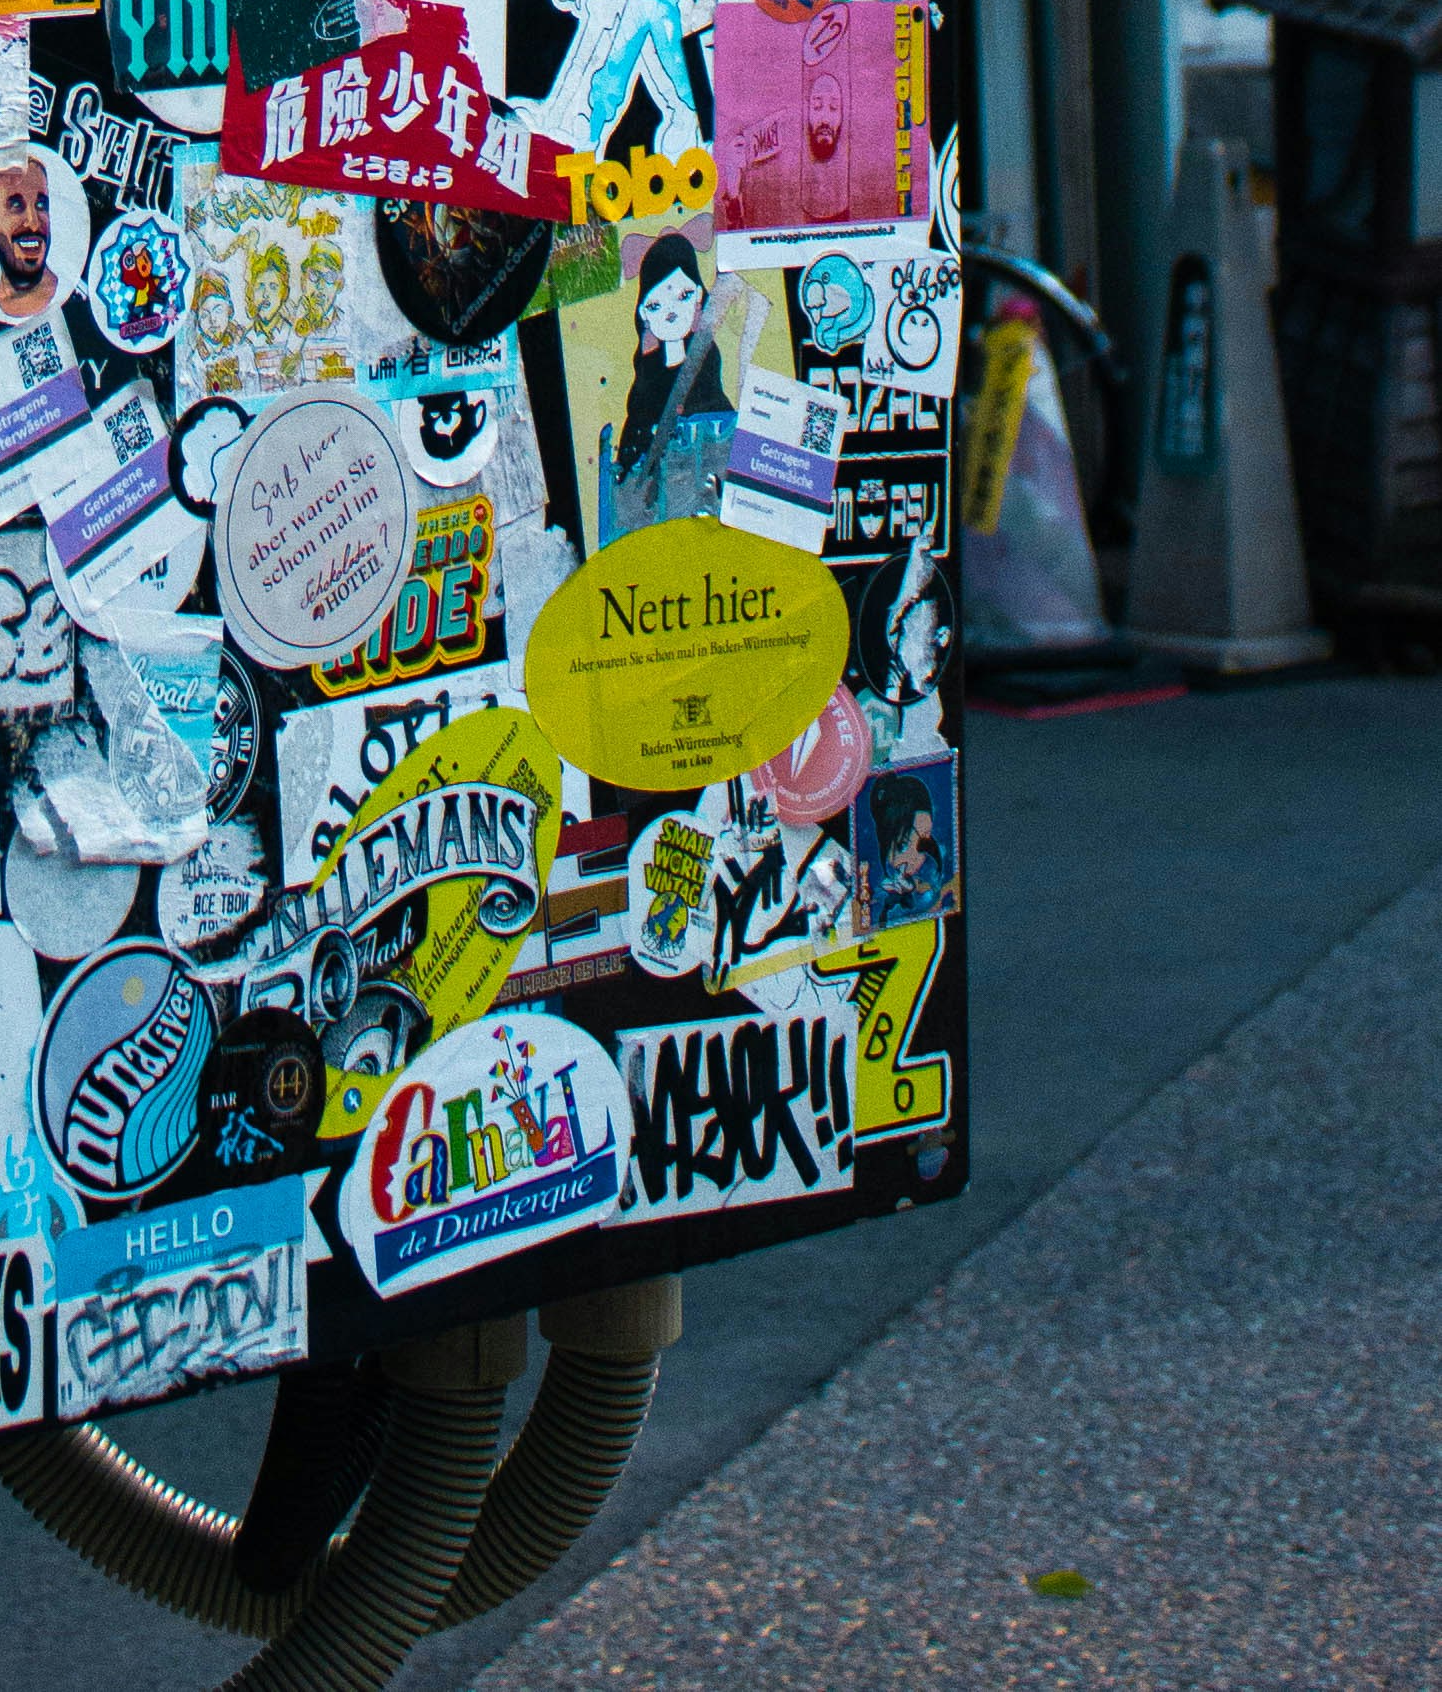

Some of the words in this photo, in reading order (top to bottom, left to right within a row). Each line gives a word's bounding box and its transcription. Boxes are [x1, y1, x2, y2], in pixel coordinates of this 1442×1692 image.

[342, 152, 454, 191] とうきょう
[749, 456, 815, 492] Unterwäsche
[759, 442, 812, 472] Getragene
[80, 475, 158, 542] Unterwäsche
[82, 465, 144, 519] Getragene
[248, 526, 288, 573] aber
[291, 478, 347, 534] waren
[349, 452, 378, 486] Sie
[261, 539, 317, 594] schon
[318, 508, 355, 546] mal
[355, 485, 380, 512] im
[598, 582, 692, 640] Nett
[701, 571, 782, 628] hier.
[568, 654, 594, 675] Aber
[594, 652, 627, 671] waren
[628, 649, 644, 667] Sie
[645, 647, 675, 665] schon
[675, 645, 696, 662] mal
[697, 643, 708, 658] in
[708, 629, 812, 656] Baden-Württemberg?
[639, 729, 743, 758] Baden-Württemberg
[670, 757, 688, 770] THE
[658, 818, 715, 856] SMALL
[643, 866, 702, 905] VINTAG
[210, 1090, 239, 1111] BAR
[125, 1205, 235, 1262] HELLO
[399, 1231, 427, 1260] de
[434, 1172, 595, 1249] Dunkerque
